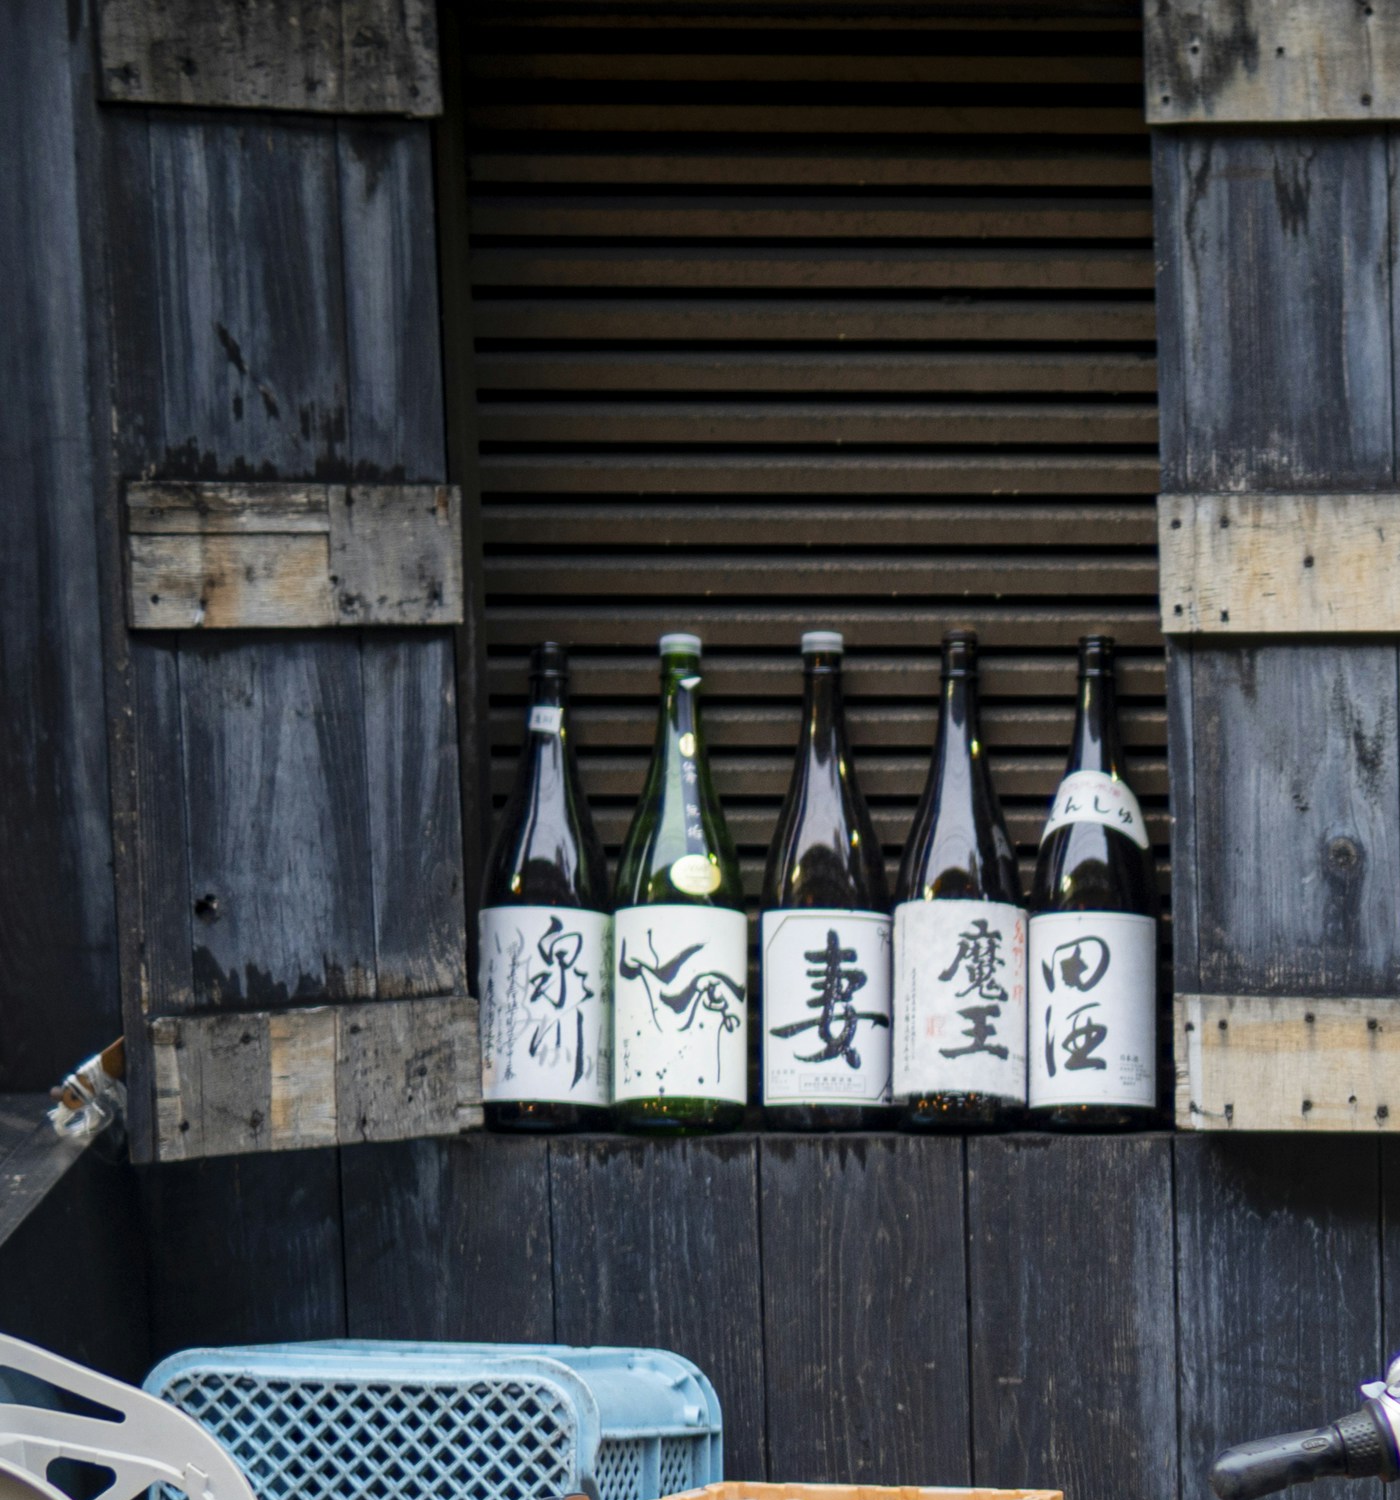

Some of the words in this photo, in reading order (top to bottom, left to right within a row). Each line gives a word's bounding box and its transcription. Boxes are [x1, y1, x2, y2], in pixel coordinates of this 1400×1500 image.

[530, 915, 595, 1091] 泉川
[769, 928, 890, 1070] 妻
[938, 918, 1009, 1060] 魔王
[1042, 936, 1110, 1077] 田酒
